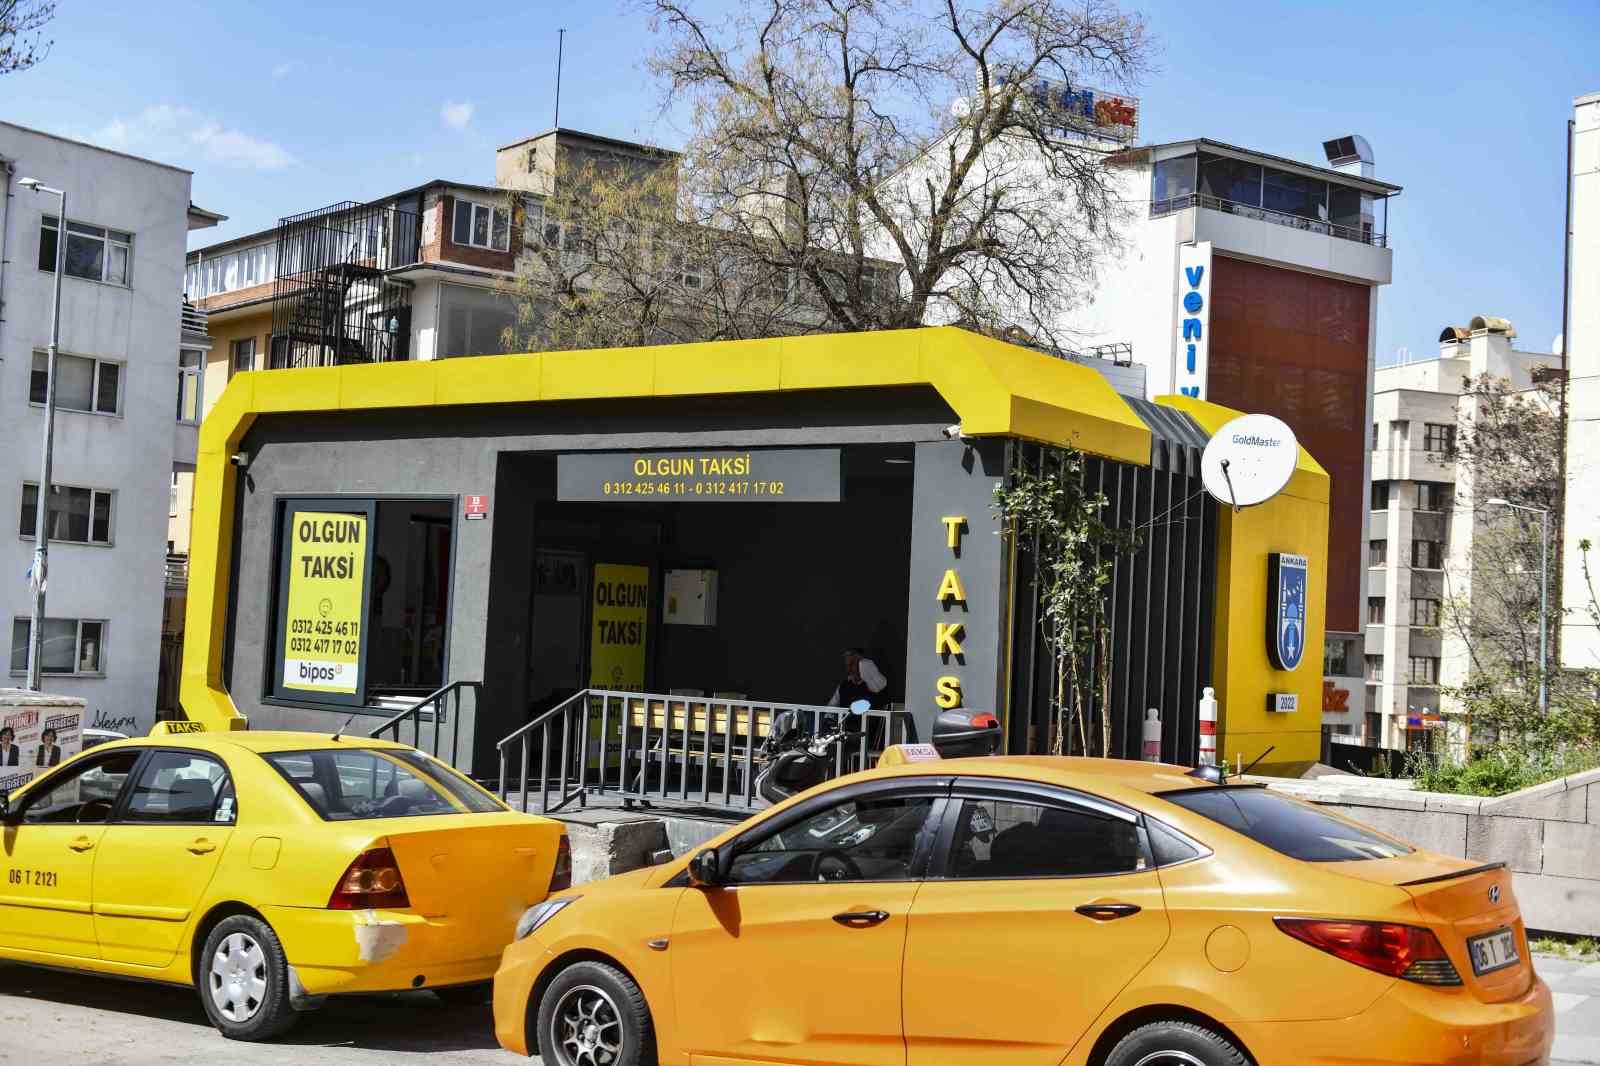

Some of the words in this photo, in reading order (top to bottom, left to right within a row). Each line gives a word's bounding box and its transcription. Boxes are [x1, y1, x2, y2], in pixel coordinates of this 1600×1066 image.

[1232, 434, 1280, 447] GoldMaster
[634, 459, 694, 476] OLGUN
[699, 454, 750, 475] TAKSİ
[604, 482, 611, 495] 0
[613, 482, 633, 495] 312
[634, 482, 654, 495] 425
[657, 482, 670, 495] 46
[674, 482, 685, 495] 11
[696, 482, 703, 495] 0
[706, 482, 725, 495] 312
[729, 482, 749, 495] 417
[753, 482, 768, 495] 17
[769, 482, 784, 495] 02
[299, 520, 360, 543] OLGUN
[301, 552, 354, 579] TAKSİ
[1281, 556, 1306, 567] ANKARA
[596, 582, 647, 608] OLGUN
[935, 516, 969, 710] TAKS
[292, 619, 313, 634] 0312
[315, 620, 332, 635] 425
[335, 621, 348, 636] 46
[351, 622, 358, 636] 11
[598, 616, 641, 645] TAKSİ
[291, 638, 311, 652] 0312
[314, 639, 330, 653] 417
[332, 640, 342, 653] 17
[345, 640, 357, 655] 02
[300, 662, 335, 683] bipos
[1280, 695, 1295, 710] 2022
[9, 869, 21, 884] 06
[25, 870, 31, 884] T
[35, 870, 57, 886] 2121
